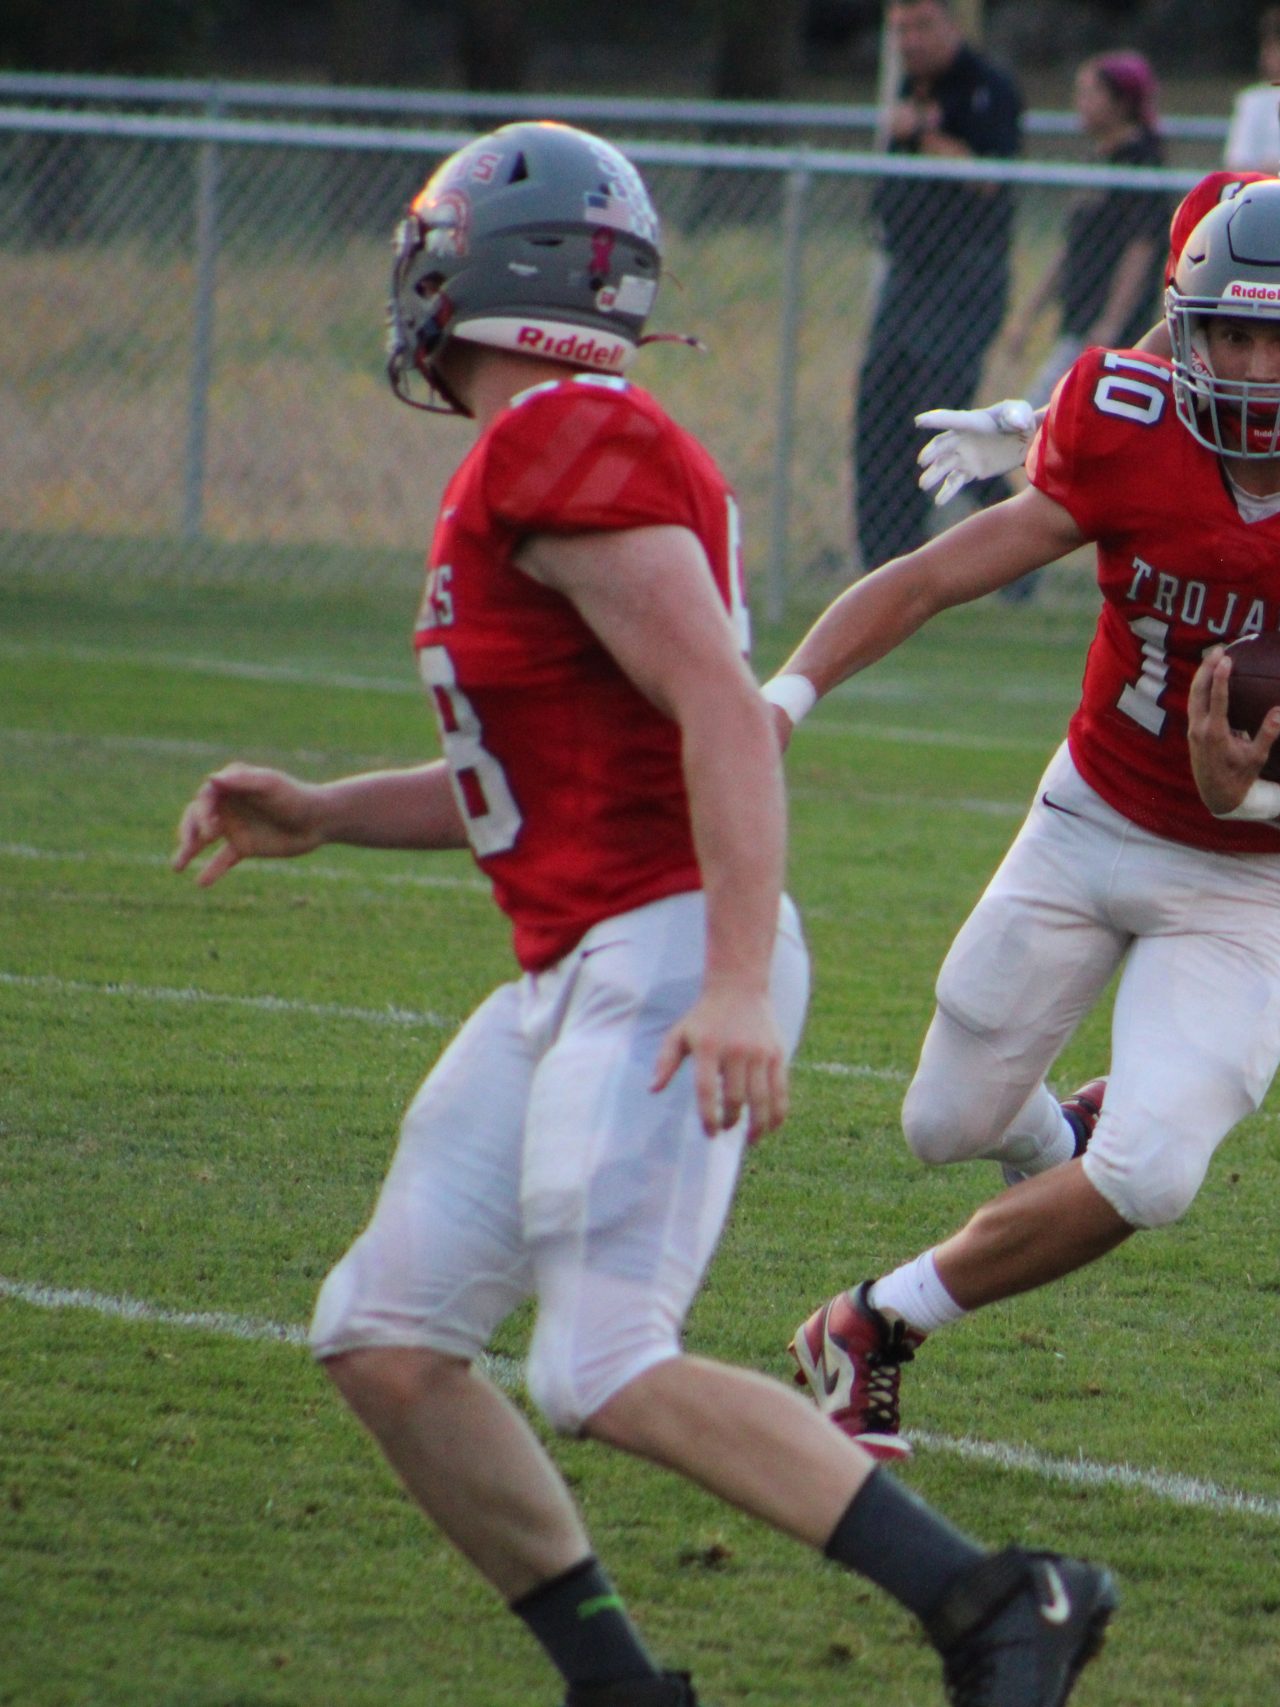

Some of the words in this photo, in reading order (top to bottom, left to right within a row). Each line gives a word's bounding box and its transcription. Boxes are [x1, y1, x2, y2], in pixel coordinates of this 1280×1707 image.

[517, 325, 625, 366] Riddell
[1093, 351, 1171, 426] 10
[420, 645, 523, 858] 8
